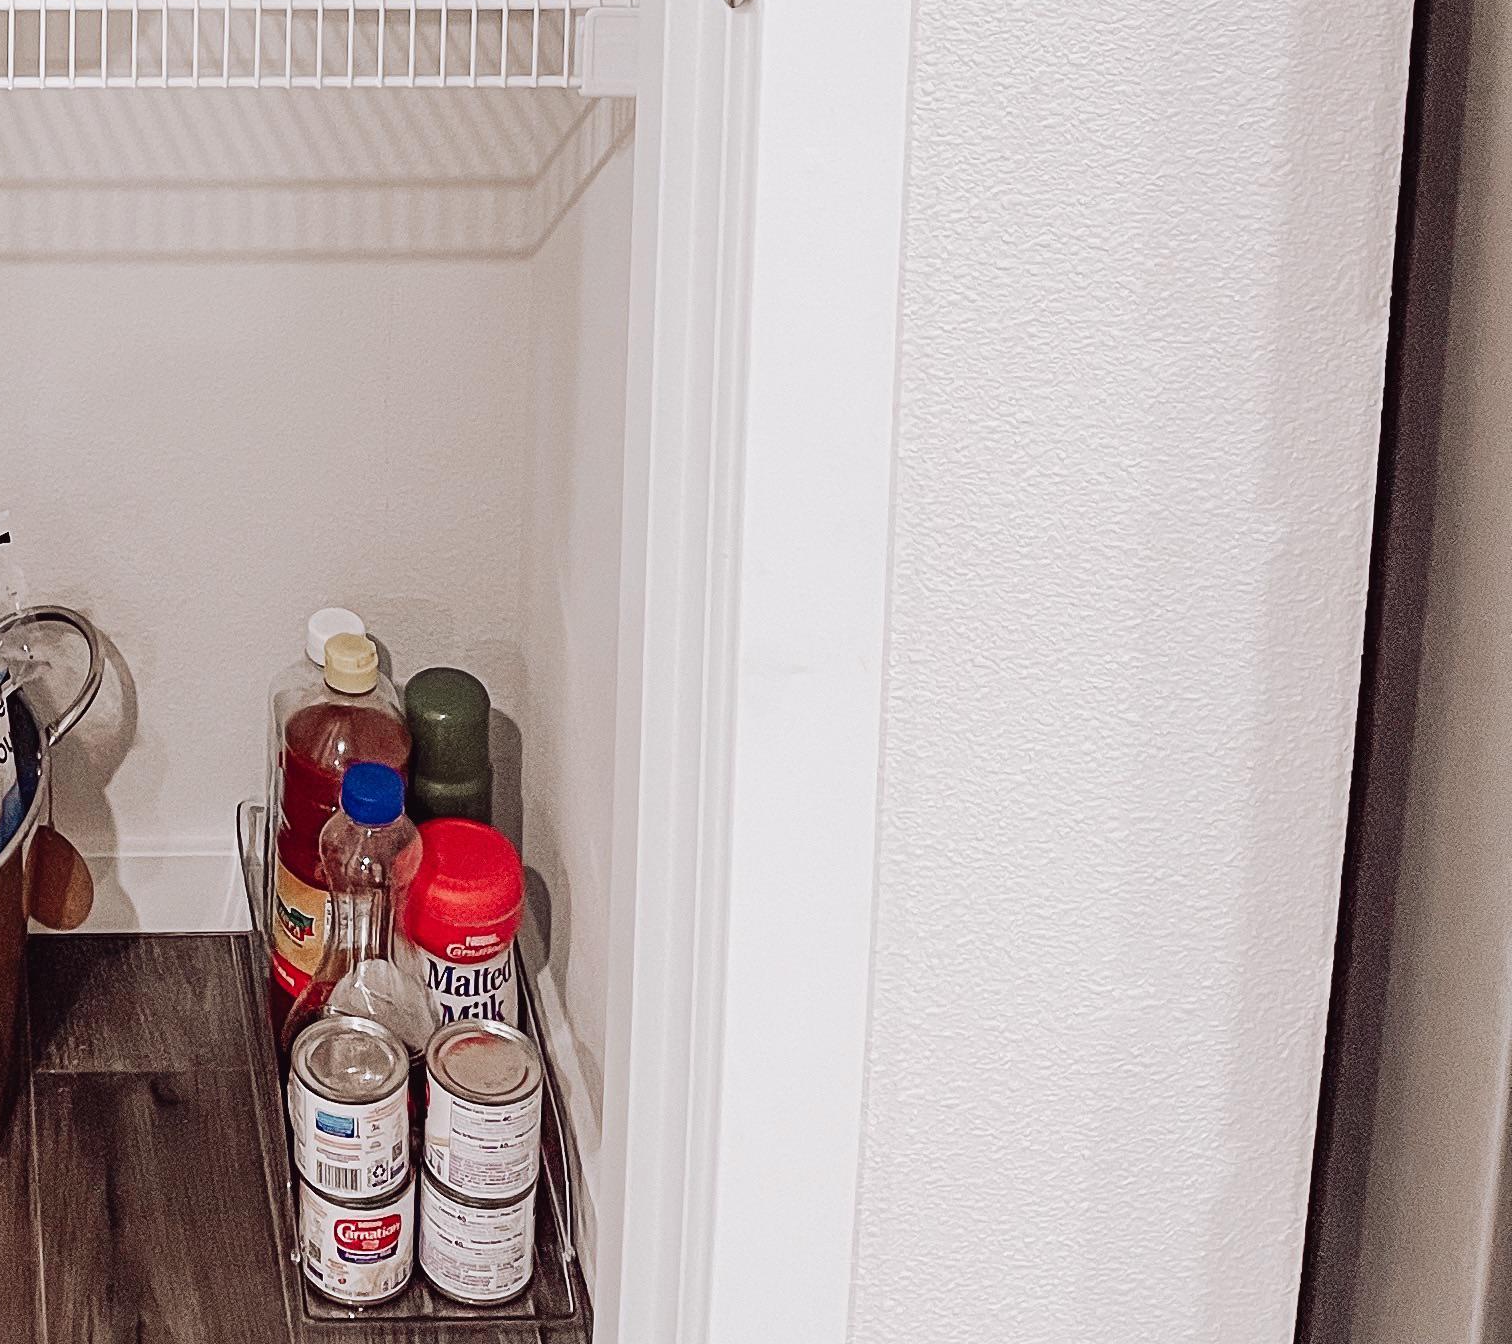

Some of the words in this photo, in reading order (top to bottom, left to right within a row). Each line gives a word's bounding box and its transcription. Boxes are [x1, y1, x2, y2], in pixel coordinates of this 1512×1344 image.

[426, 958, 512, 998] Malted
[440, 993, 505, 1026] Milk
[336, 1222, 401, 1243] Carnation
